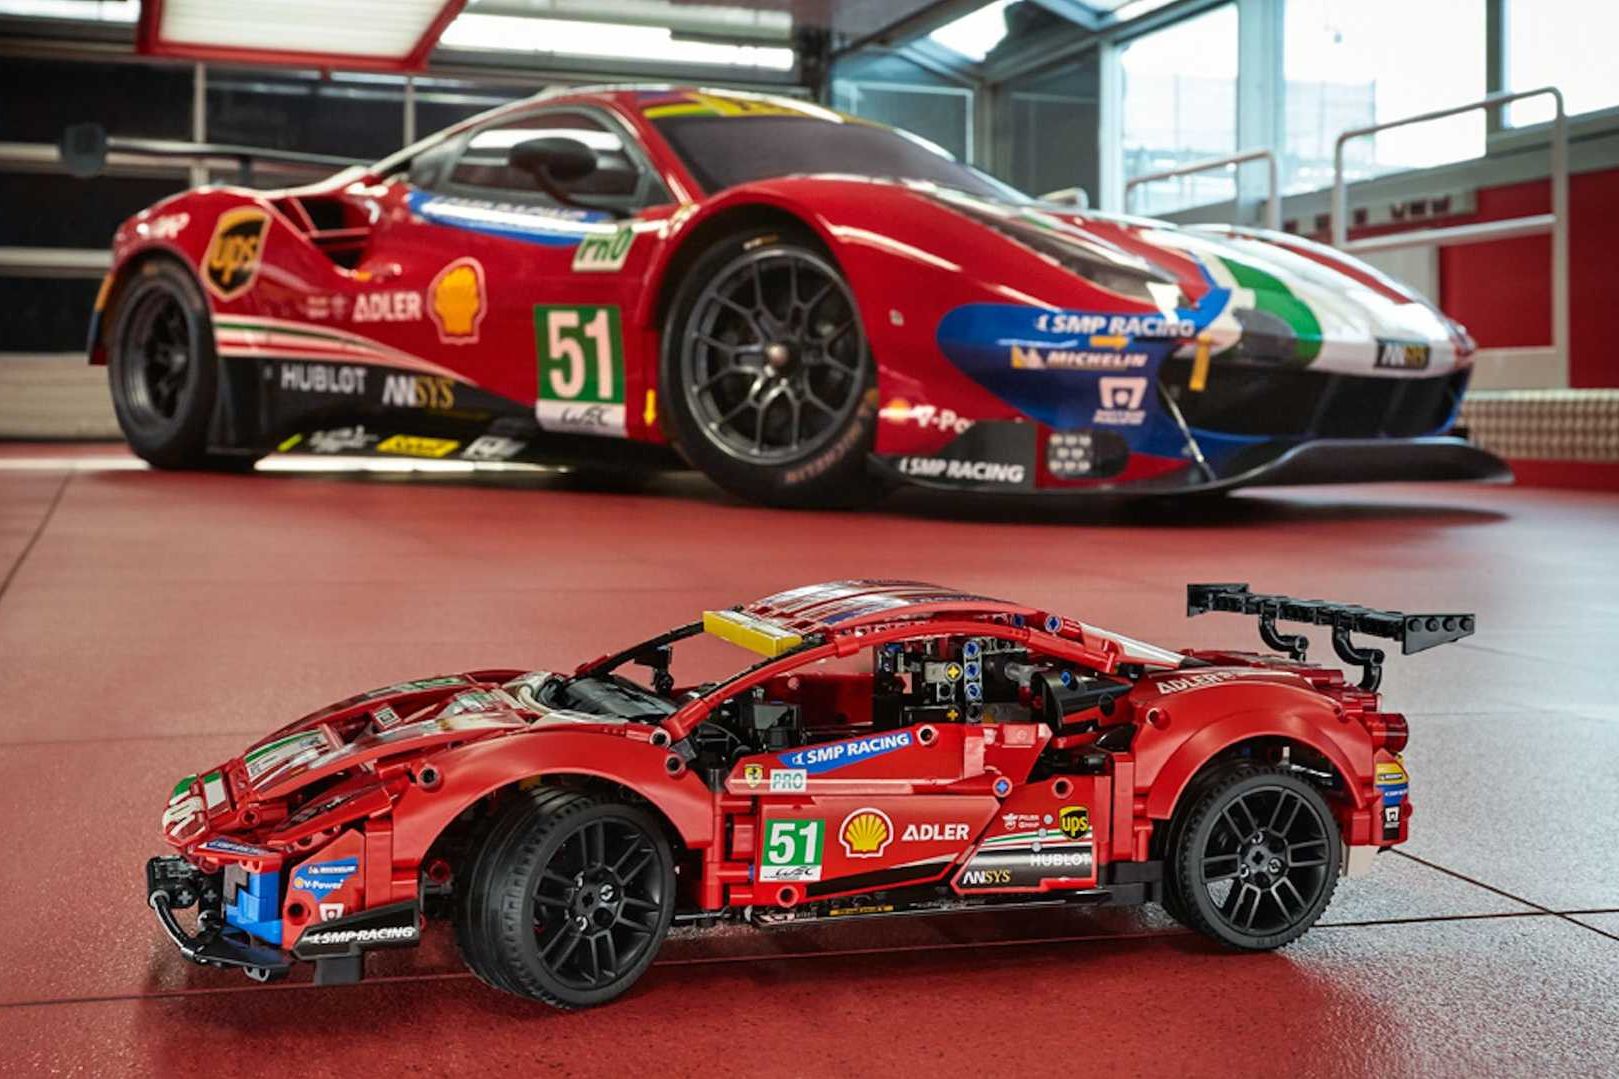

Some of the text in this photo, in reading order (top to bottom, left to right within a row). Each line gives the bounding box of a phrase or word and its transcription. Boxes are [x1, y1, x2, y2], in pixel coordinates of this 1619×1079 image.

[352, 291, 421, 322] ADLER
[1052, 315, 1196, 338] SMP RACING
[547, 309, 614, 399] 51
[1046, 351, 1148, 369] MICHELIN
[280, 363, 367, 395] HUBLOT
[382, 373, 455, 410] ANSYS
[909, 457, 1025, 483] SMP RACING
[1156, 673, 1224, 695] ADLER
[806, 732, 910, 764] SMP RACING
[771, 771, 804, 789] PRO
[901, 823, 970, 841] ADLER
[1061, 816, 1088, 837] ups
[768, 822, 818, 864] 51
[1030, 852, 1092, 867] HUBLOT
[962, 870, 1011, 884] ANSYS
[321, 925, 415, 944] SMP RACING
